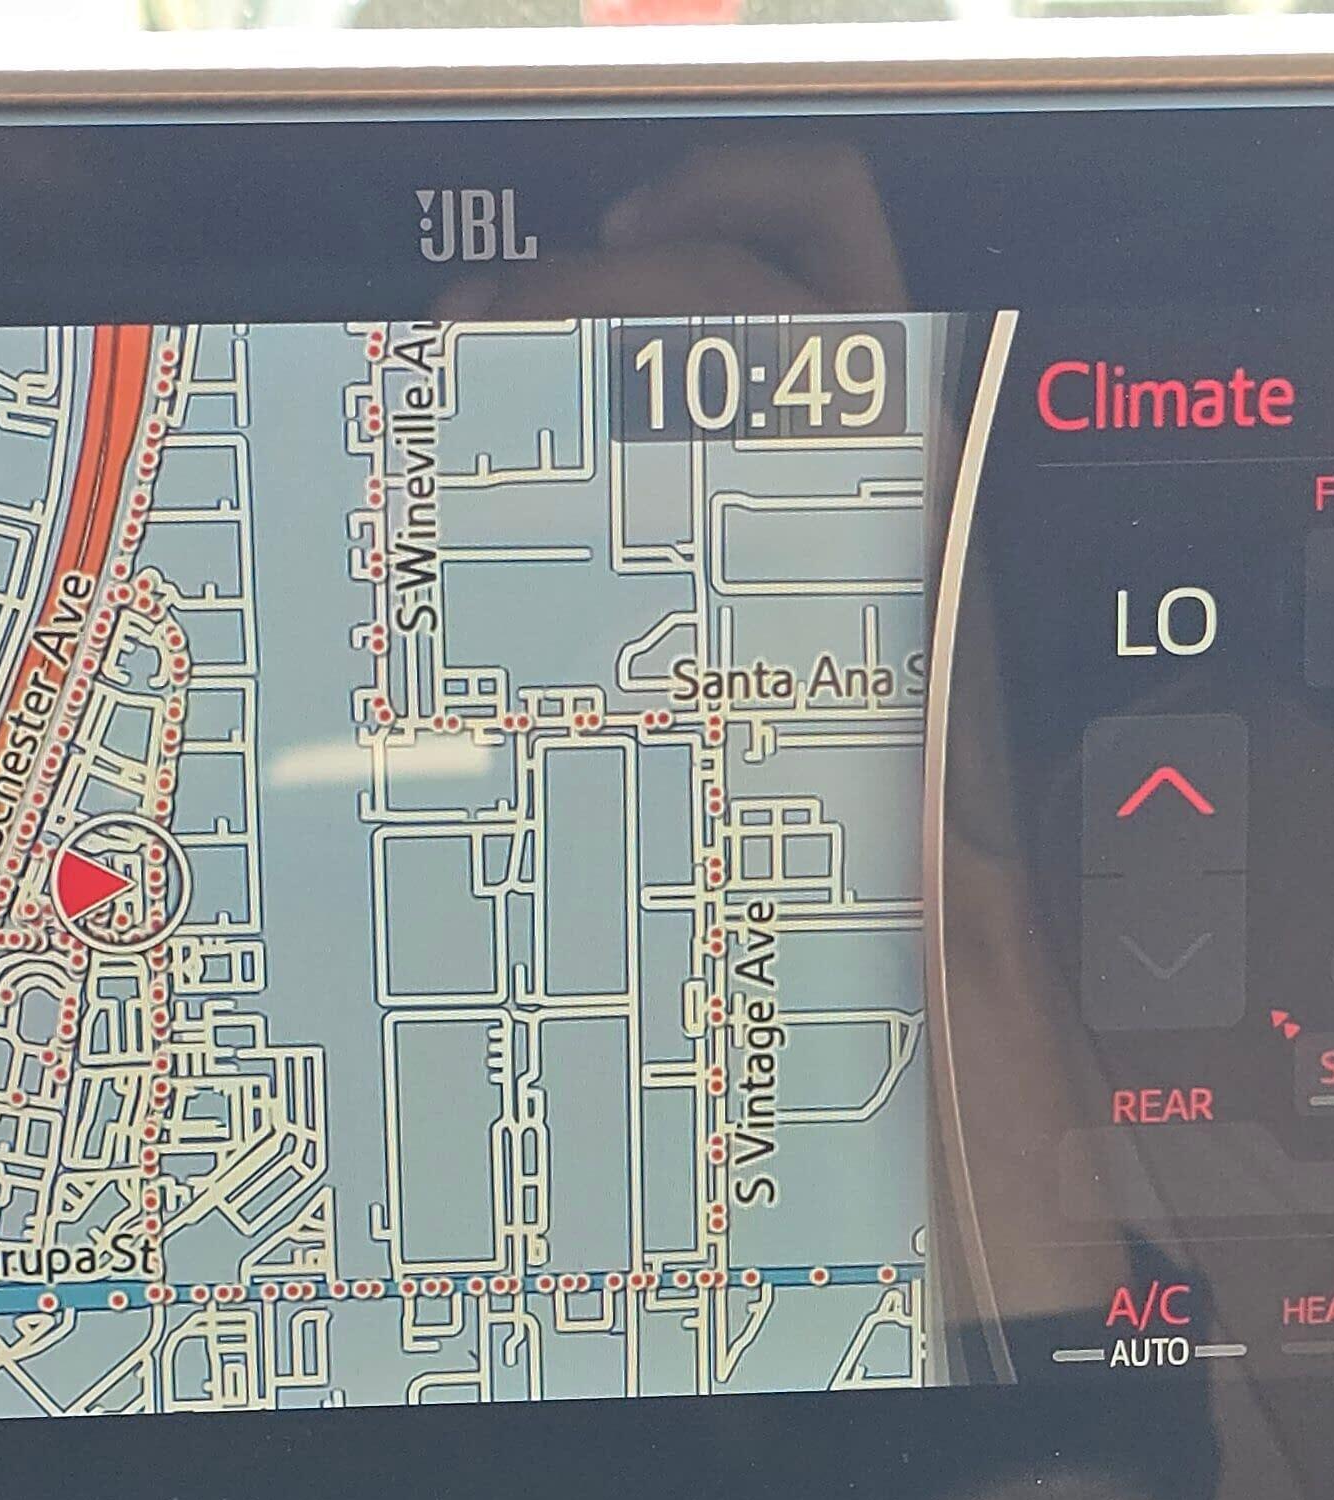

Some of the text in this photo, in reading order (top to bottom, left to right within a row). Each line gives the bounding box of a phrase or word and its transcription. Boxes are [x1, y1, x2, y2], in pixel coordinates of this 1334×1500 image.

[415, 188, 538, 262] JBL
[633, 334, 888, 431] 10:49
[1036, 360, 1296, 431] Climate
[392, 386, 439, 603] Wineville
[33, 573, 94, 668] Ave
[1115, 586, 1218, 658] LO
[672, 657, 794, 703] Santa
[807, 655, 895, 699] Ana
[733, 900, 786, 1205] S Vintage Ave
[1111, 1087, 1214, 1126] REAR
[110, 1233, 157, 1274] St
[1105, 1280, 1191, 1333] A/C
[1109, 1336, 1190, 1368] AUTO
